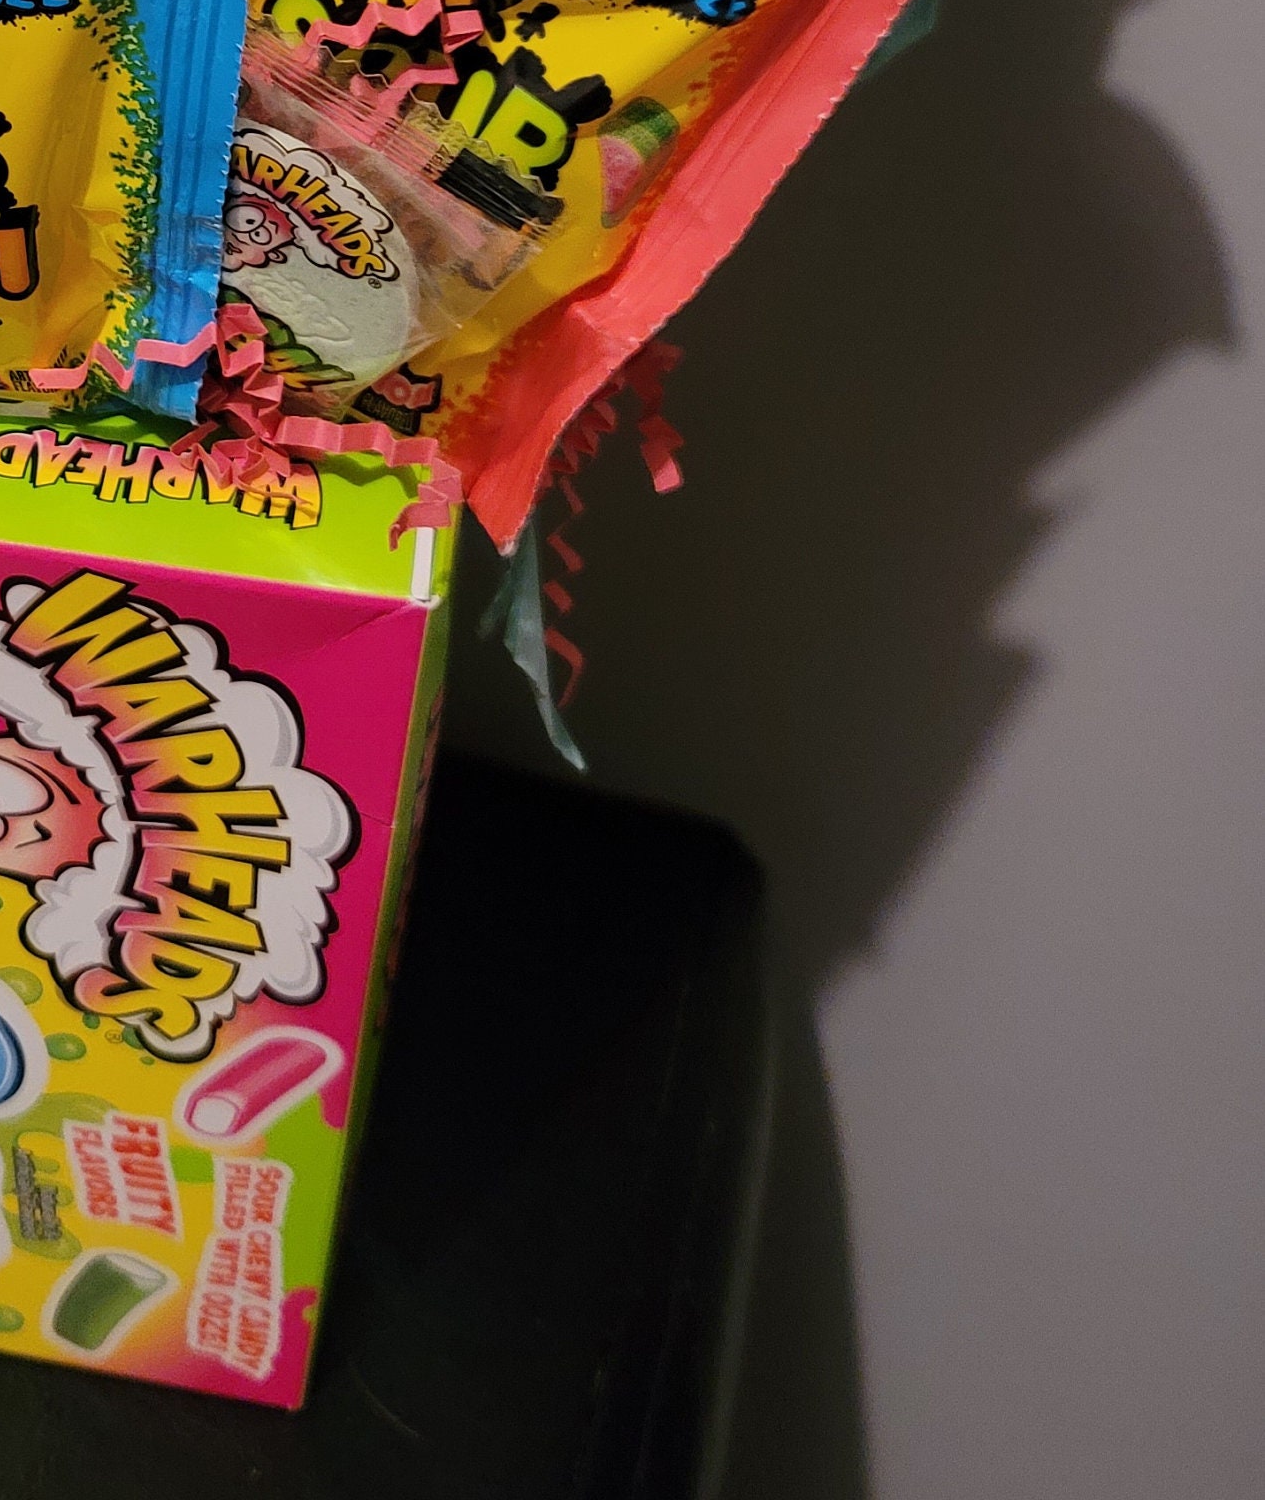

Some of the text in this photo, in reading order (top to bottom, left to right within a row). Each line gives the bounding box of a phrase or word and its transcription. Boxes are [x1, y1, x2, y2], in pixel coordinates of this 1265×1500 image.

[2, 568, 292, 1042] WARHEADS
[71, 1125, 120, 1218] FLAVORS
[111, 1114, 178, 1235] FRUITY
[221, 1162, 252, 1231] FILLED
[206, 1237, 241, 1287] WITH
[236, 1164, 283, 1371] SOUR CHEWY CANDY
